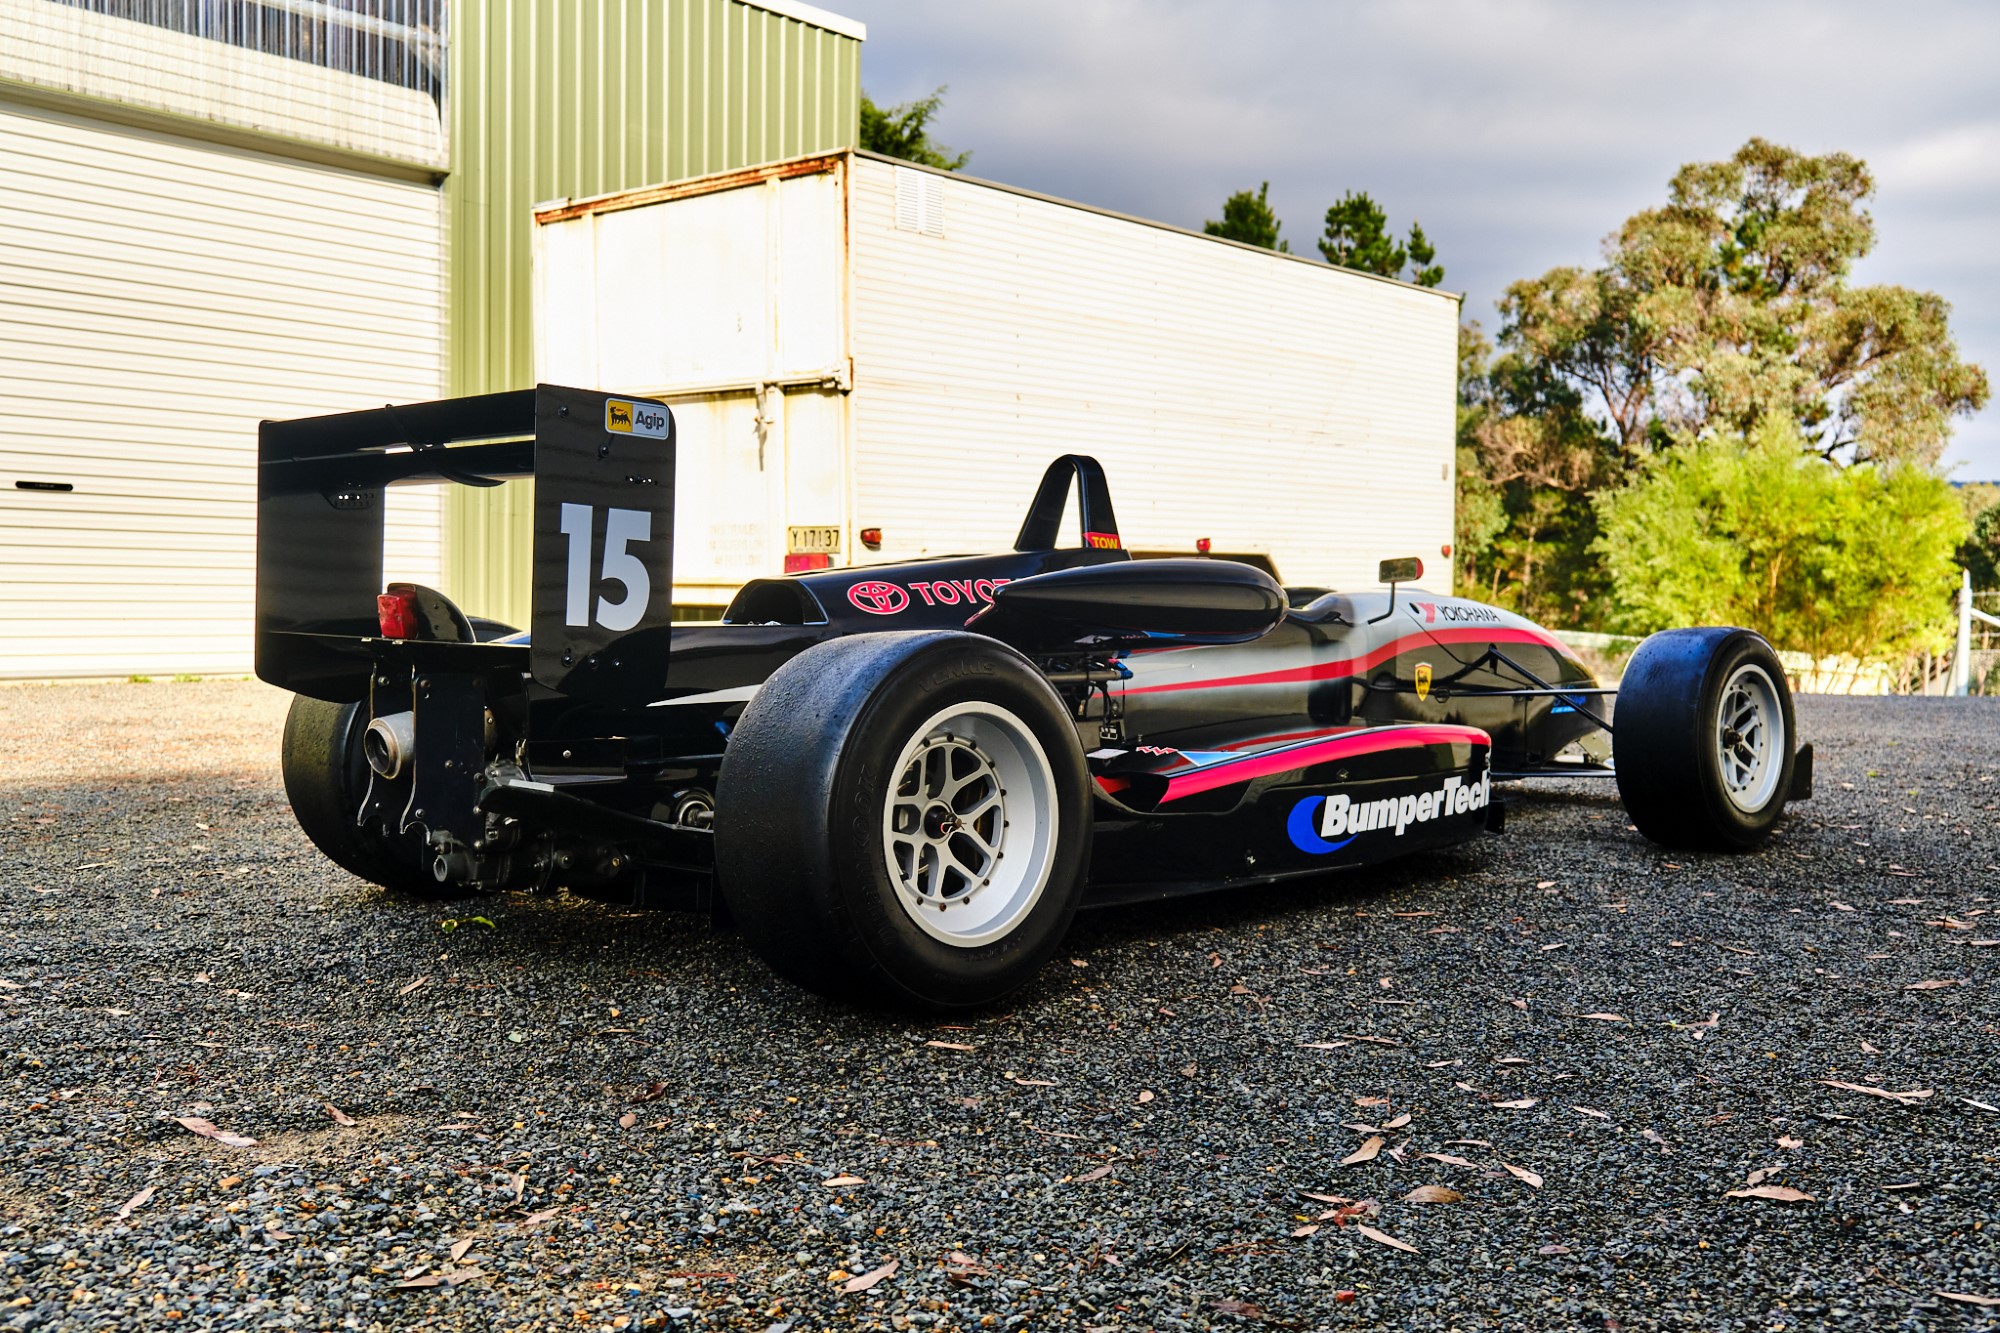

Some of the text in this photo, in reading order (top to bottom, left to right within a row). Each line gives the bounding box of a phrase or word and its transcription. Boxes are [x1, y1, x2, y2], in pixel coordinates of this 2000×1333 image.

[635, 410, 665, 430] Agip
[1091, 536, 1118, 549] TOW
[560, 502, 651, 632] 15
[907, 578, 1018, 606] TOYO
[1436, 605, 1501, 622] YOKOHAMA
[1320, 769, 1490, 838] BumperTech
